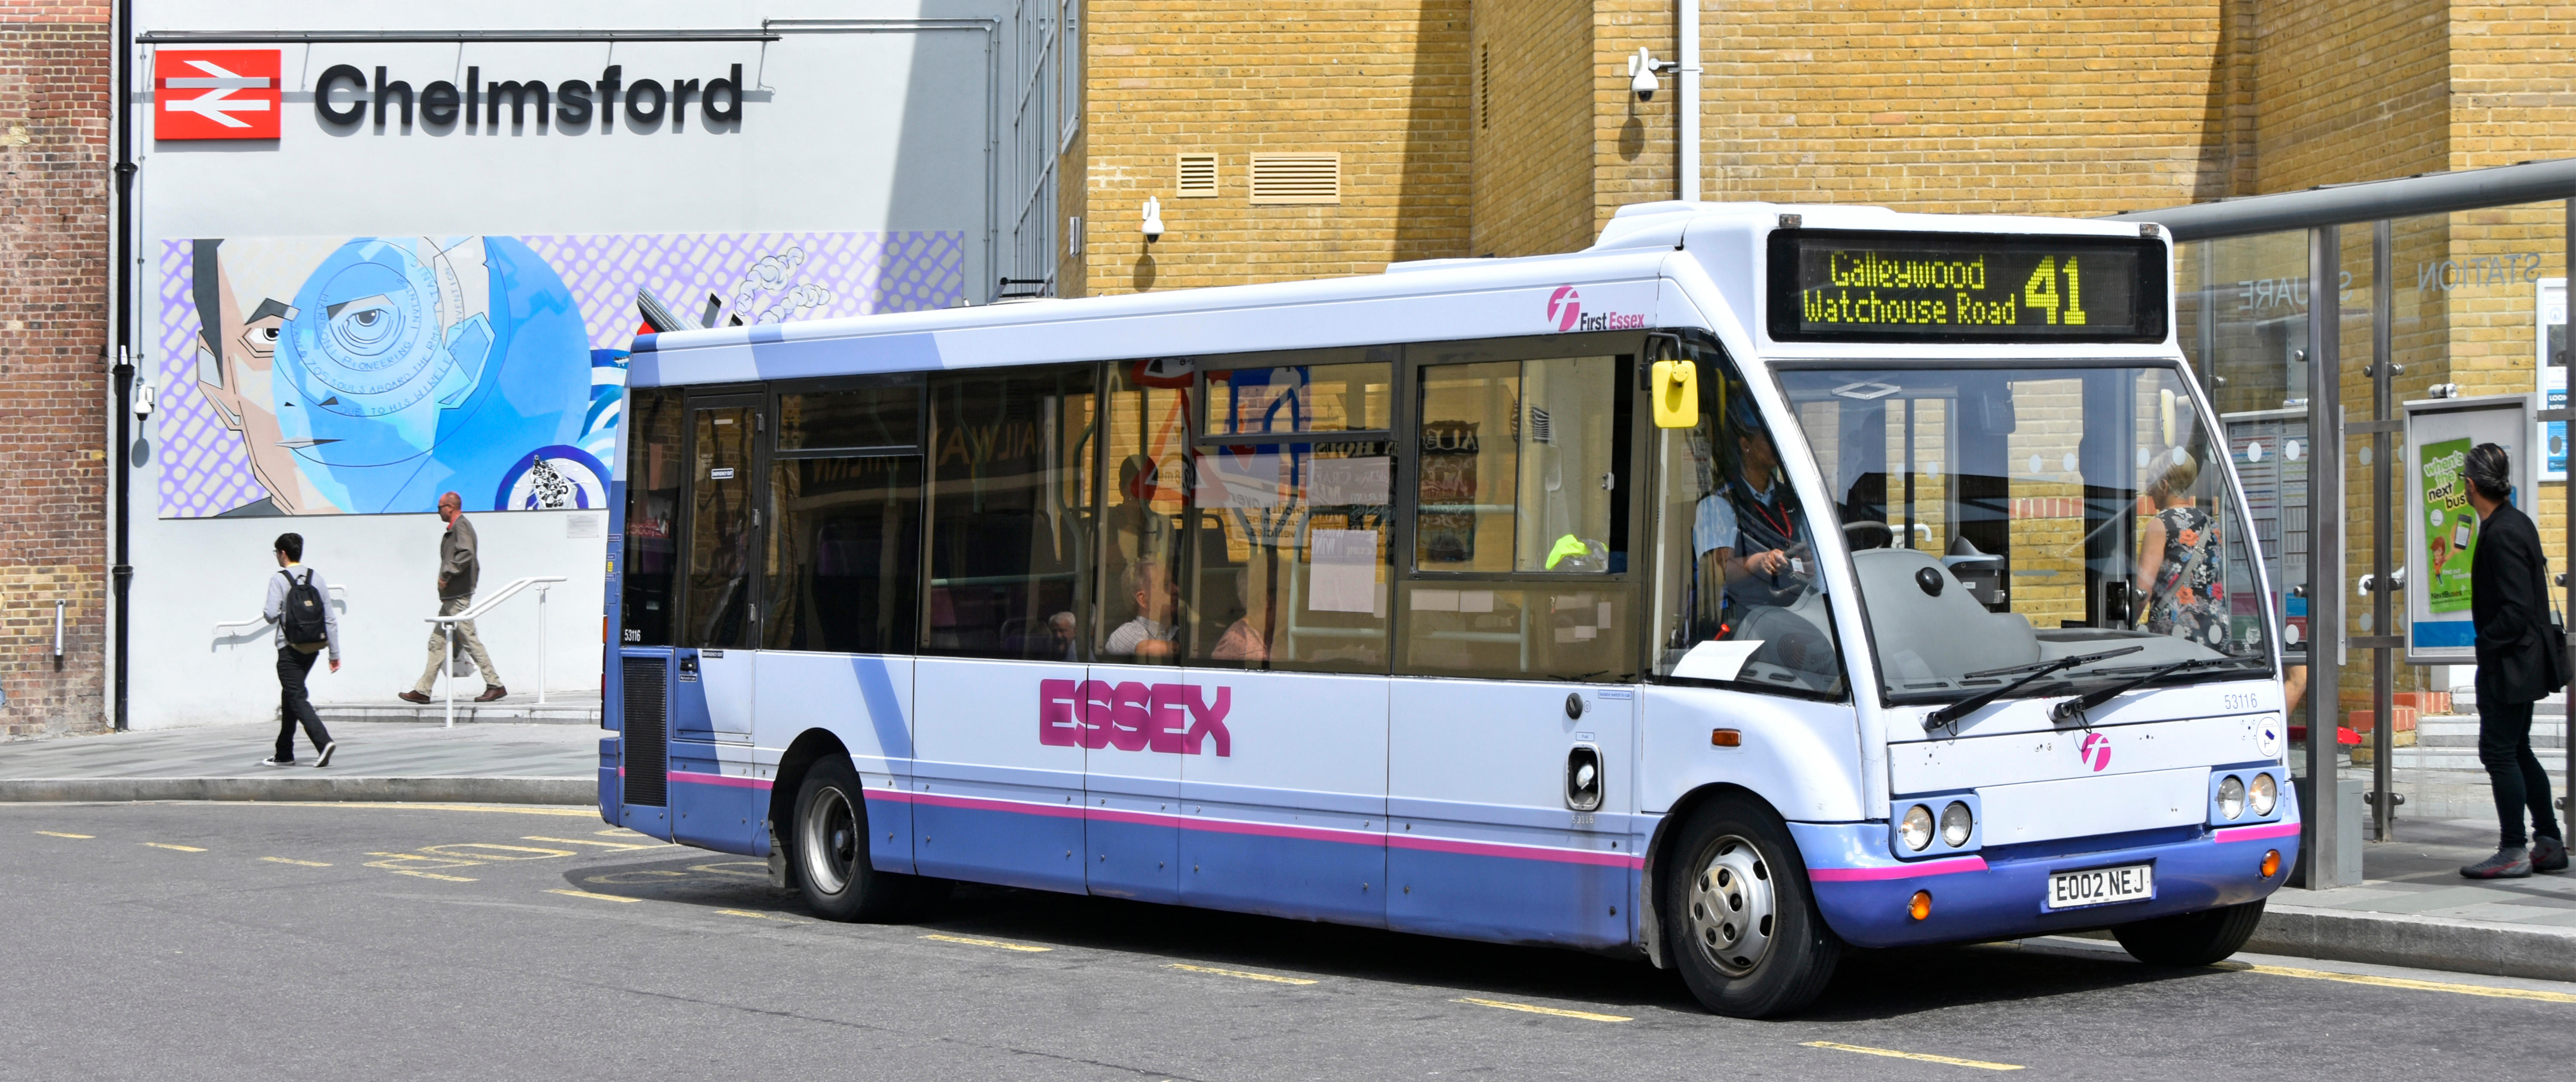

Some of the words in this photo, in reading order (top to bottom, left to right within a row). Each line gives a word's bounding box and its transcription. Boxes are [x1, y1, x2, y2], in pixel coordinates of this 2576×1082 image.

[315, 63, 742, 125] Chelmsford
[1830, 250, 1984, 290] Galleywood
[2024, 254, 2087, 325] 41
[1803, 290, 1947, 325] Watchouse
[1956, 292, 2016, 325] Road
[316, 293, 337, 356] MARCONI
[342, 341, 411, 370] PIONEERING
[396, 278, 421, 329] INVENTOR
[1580, 312, 1607, 331] First
[1609, 312, 1645, 330] Essex
[340, 407, 361, 416] DUE
[371, 407, 386, 415] TO
[389, 398, 411, 412] HIS
[413, 341, 460, 399] WIRELESS
[444, 267, 463, 330] INVENTION
[306, 359, 329, 382] 705
[330, 379, 365, 394] SOULS
[369, 373, 411, 394] ABOARD
[413, 355, 429, 372] THE
[426, 324, 441, 351] RMS
[2425, 451, 2464, 476] when's
[2428, 482, 2453, 501] next
[2436, 471, 2455, 485] the
[2445, 494, 2466, 509] bus
[624, 629, 641, 642] 53116
[2224, 693, 2257, 710] 53116
[1039, 678, 1231, 757] ESSEX
[1572, 815, 1594, 824] 53116
[2108, 869, 2144, 896] NEJ
